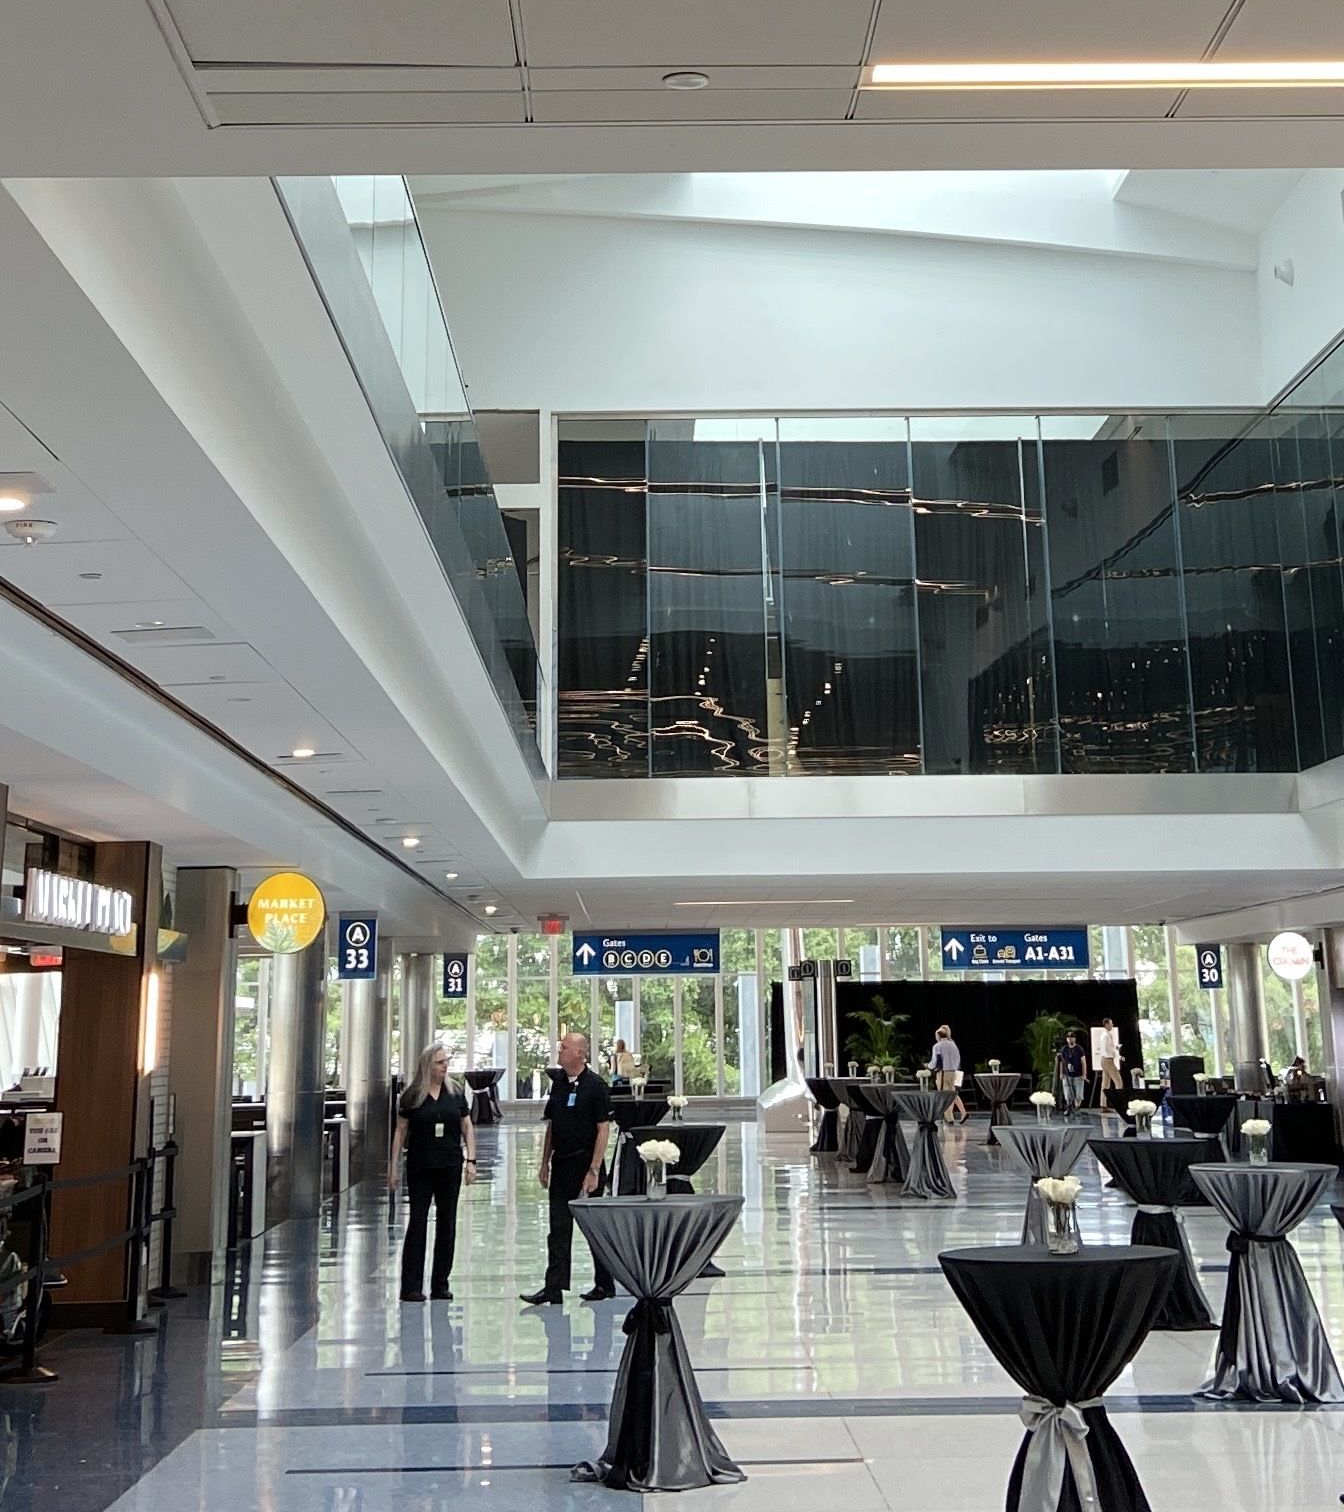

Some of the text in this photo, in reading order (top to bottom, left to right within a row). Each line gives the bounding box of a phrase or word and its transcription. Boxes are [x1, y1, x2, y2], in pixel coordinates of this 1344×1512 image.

[257, 898, 316, 909] MARKET
[264, 912, 308, 924] PLACE
[351, 926, 366, 942] A
[970, 933, 998, 943] Exit to
[1023, 933, 1048, 943] Gates
[602, 938, 627, 948] Gates
[345, 948, 369, 968] 33
[1024, 946, 1075, 961] A1-A31
[1201, 968, 1219, 983] 30
[447, 978, 463, 992] 31
